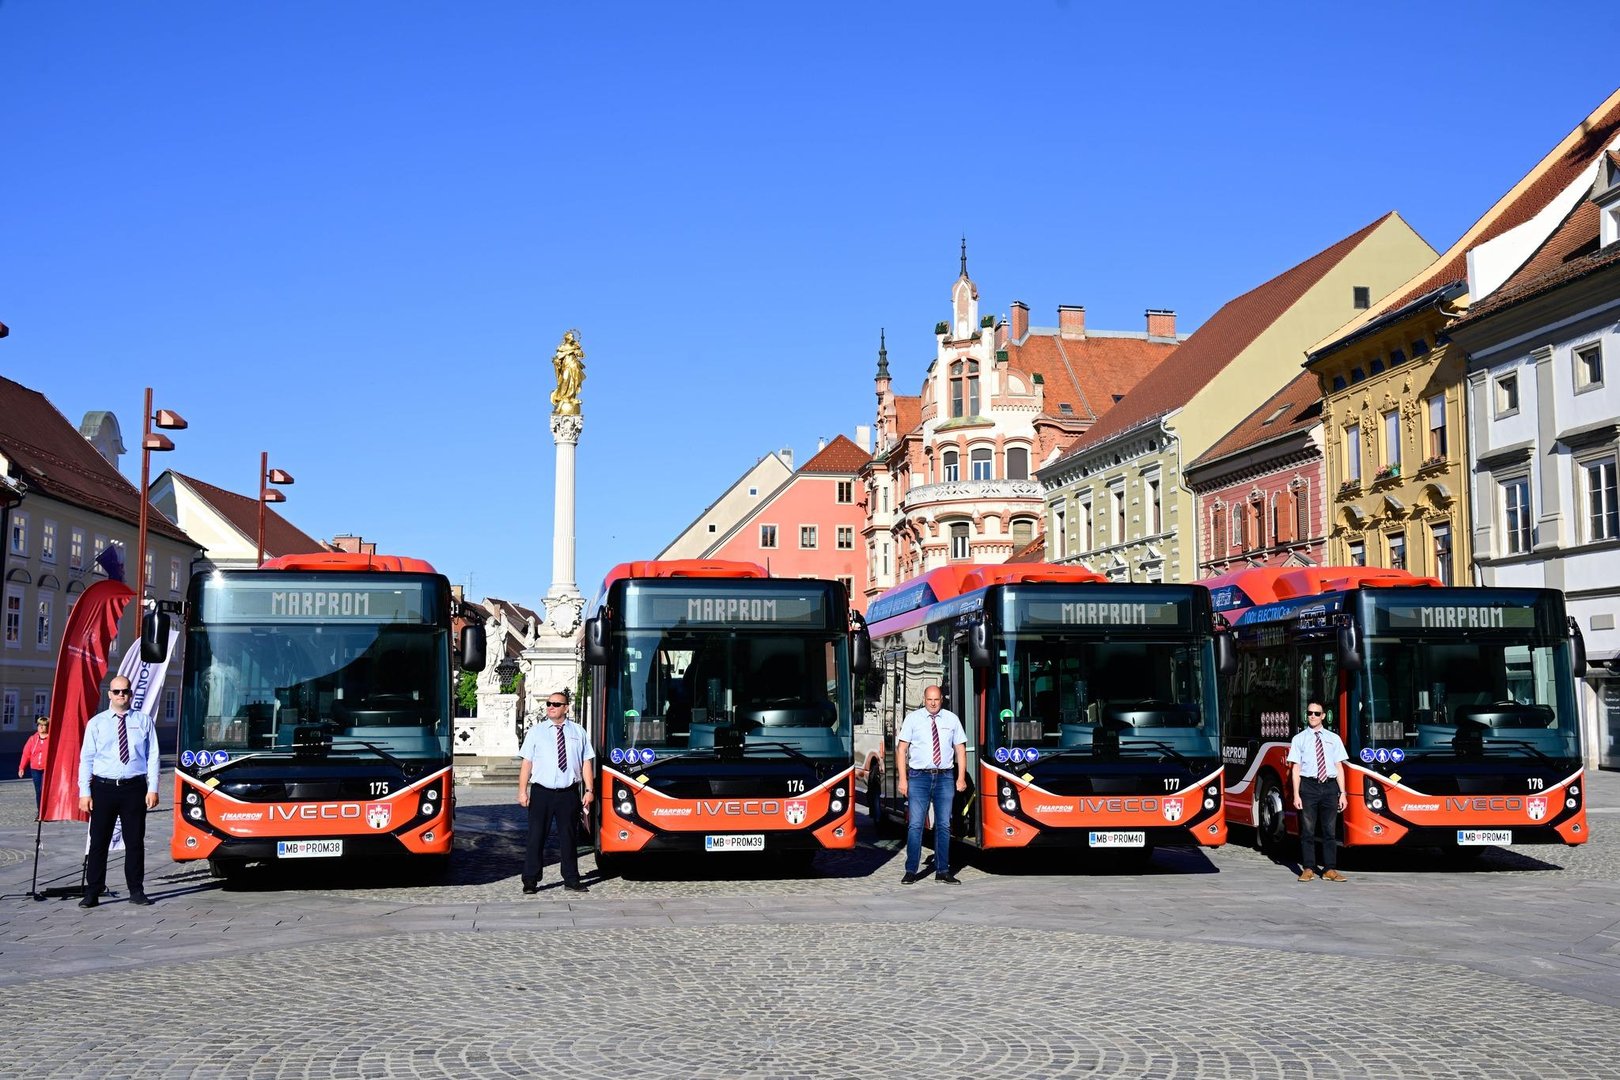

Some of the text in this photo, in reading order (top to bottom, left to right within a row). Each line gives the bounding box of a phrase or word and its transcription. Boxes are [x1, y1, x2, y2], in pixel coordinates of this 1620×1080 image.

[271, 592, 369, 616] MARPROM
[687, 598, 777, 621] MARPROM
[1061, 603, 1146, 624] MARPROM
[1421, 607, 1504, 627] MARPROM
[133, 661, 151, 711] BILNOS
[369, 782, 389, 795] 175
[787, 780, 805, 793] 176
[1163, 778, 1180, 790] 177
[1527, 778, 1544, 790] 178
[695, 801, 780, 816] IVECO
[1079, 798, 1159, 812] IVECO
[1445, 797, 1523, 811] IVECO
[268, 803, 361, 820] IVECO
[712, 837, 725, 847] MB
[1096, 834, 1107, 843] MB
[1465, 832, 1476, 841] MB
[286, 843, 299, 853] MB
